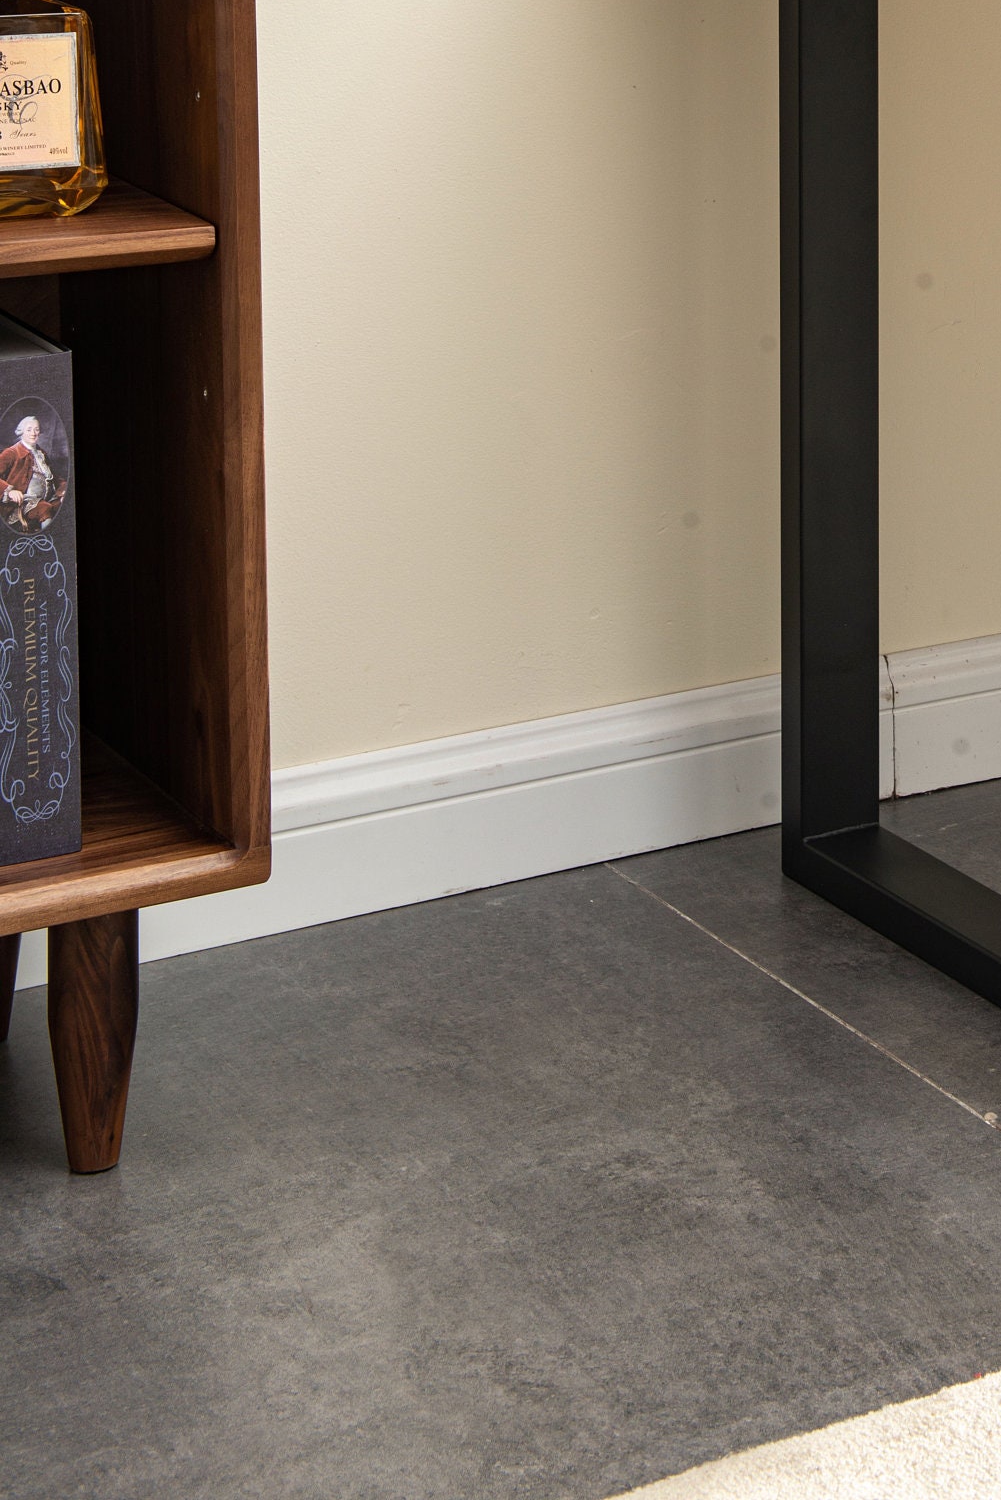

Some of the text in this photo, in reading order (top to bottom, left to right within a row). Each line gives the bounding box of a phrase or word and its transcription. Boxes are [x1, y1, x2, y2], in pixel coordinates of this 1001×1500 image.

[23, 578, 40, 781] PREMIUM QUALITY
[39, 601, 51, 754] VECTOR ELEMENTS
